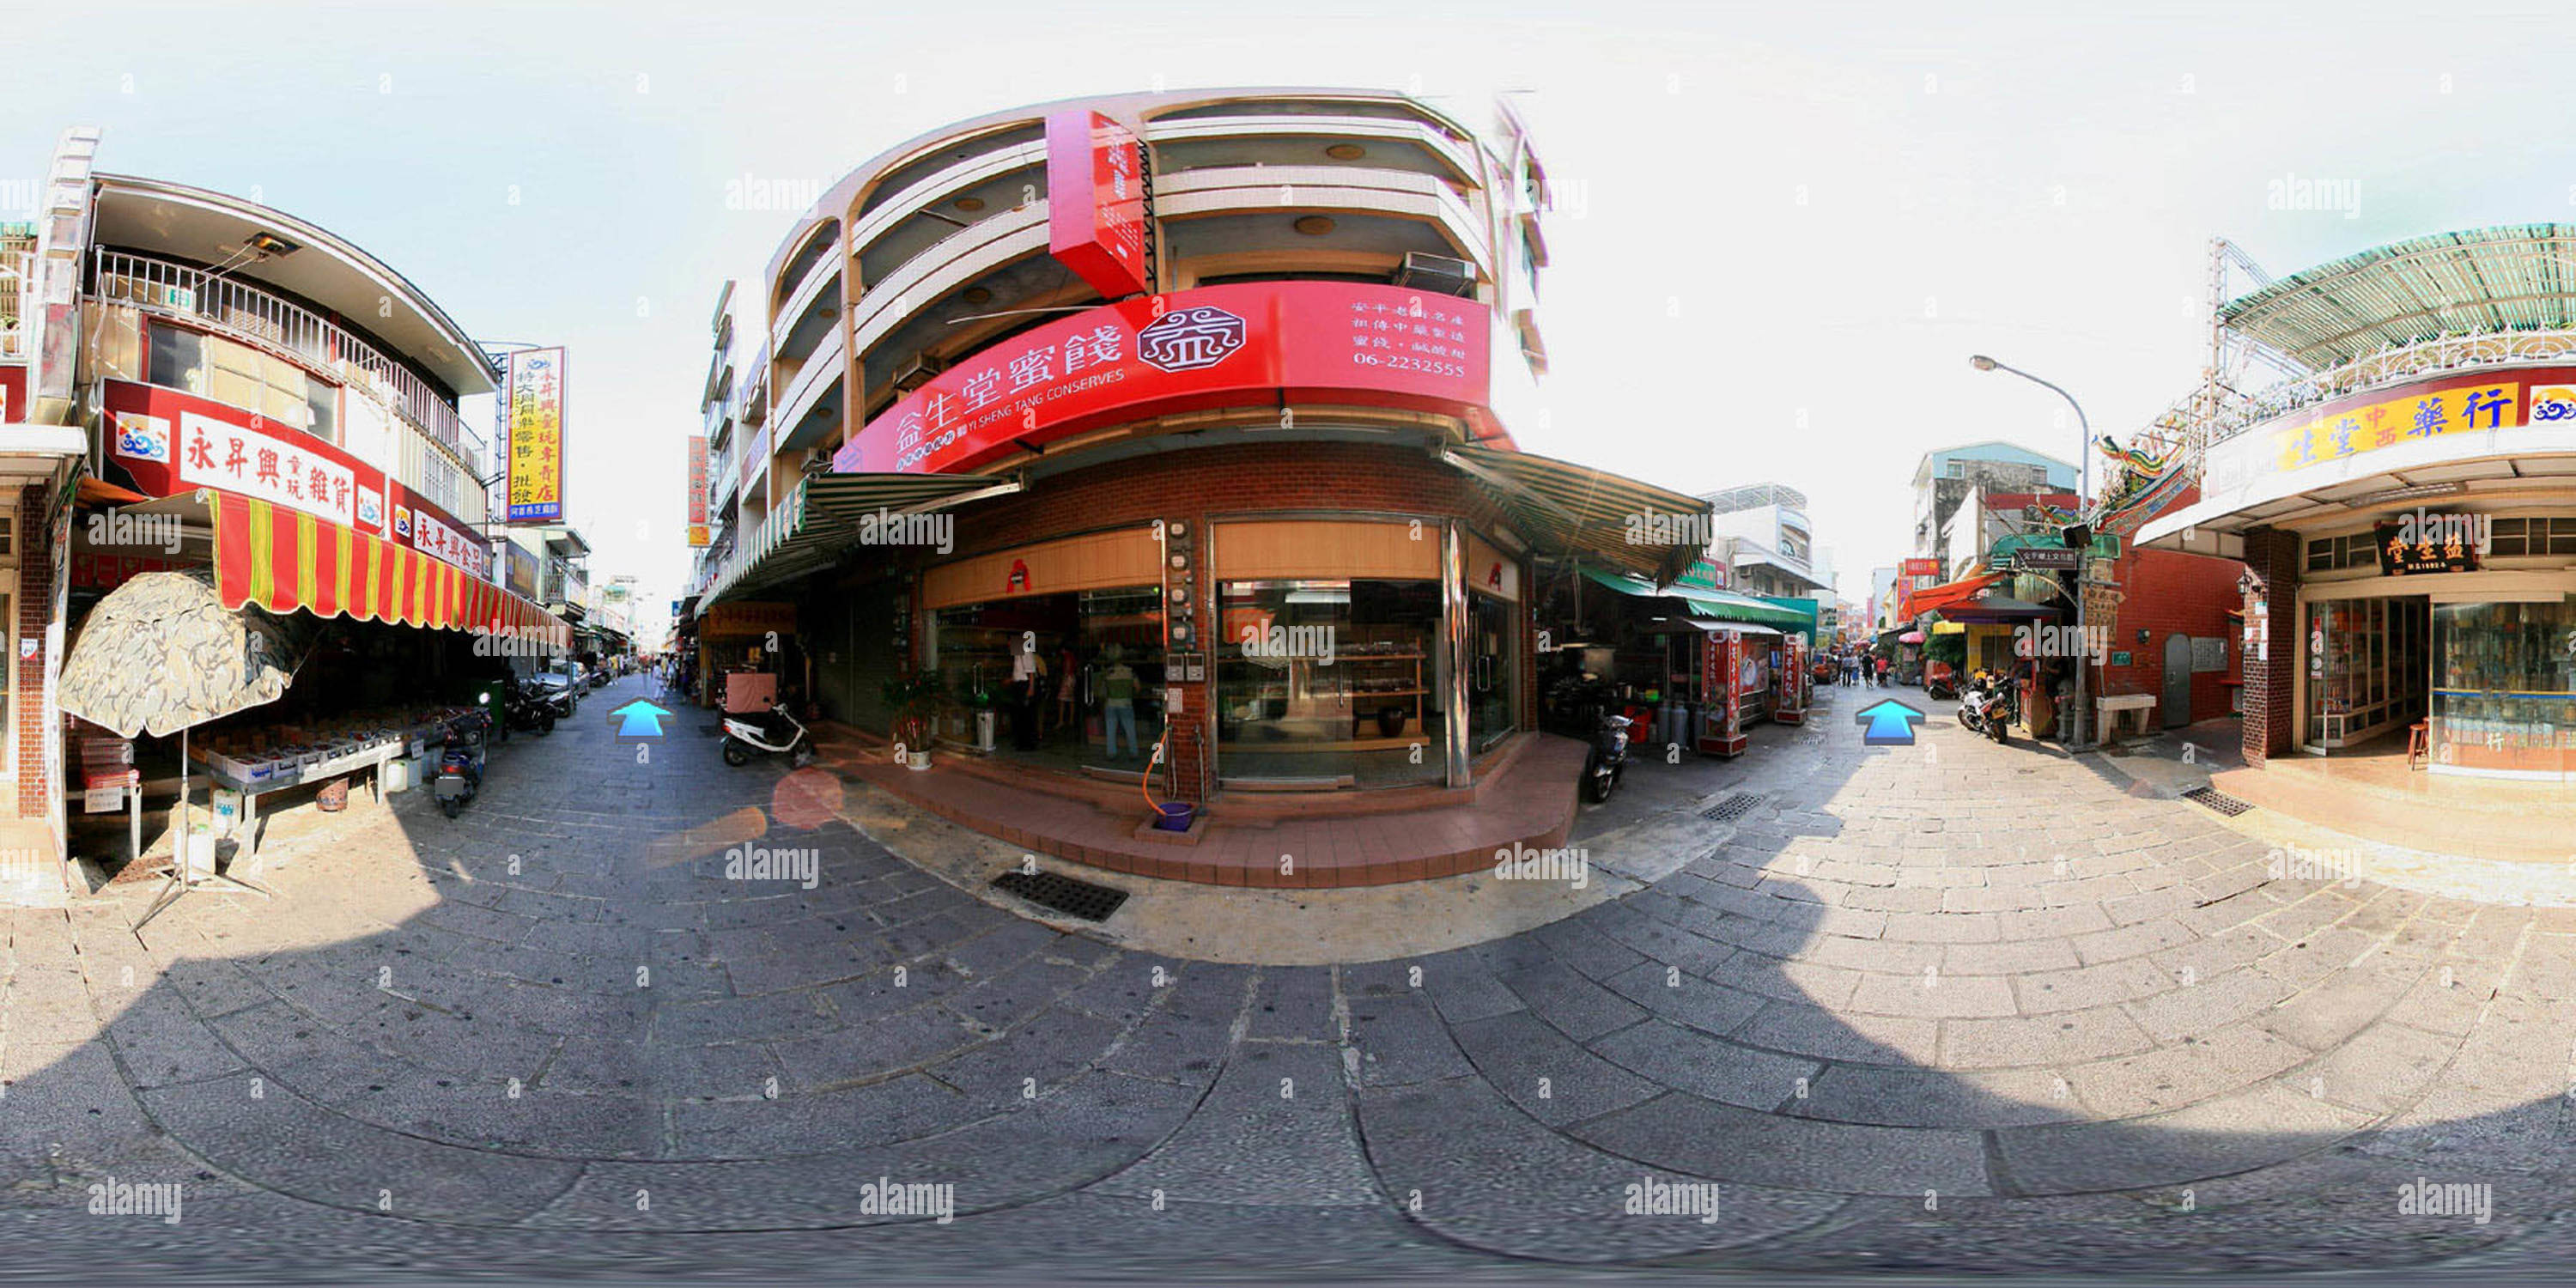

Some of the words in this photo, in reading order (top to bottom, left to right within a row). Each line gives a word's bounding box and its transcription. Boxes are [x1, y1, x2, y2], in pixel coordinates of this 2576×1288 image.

[896, 325, 1122, 455] 益生堂蜜餞
[1353, 352, 1465, 379] 06-2232555
[979, 405, 1012, 428] SHENG
[1047, 368, 1125, 401] CONSERVES
